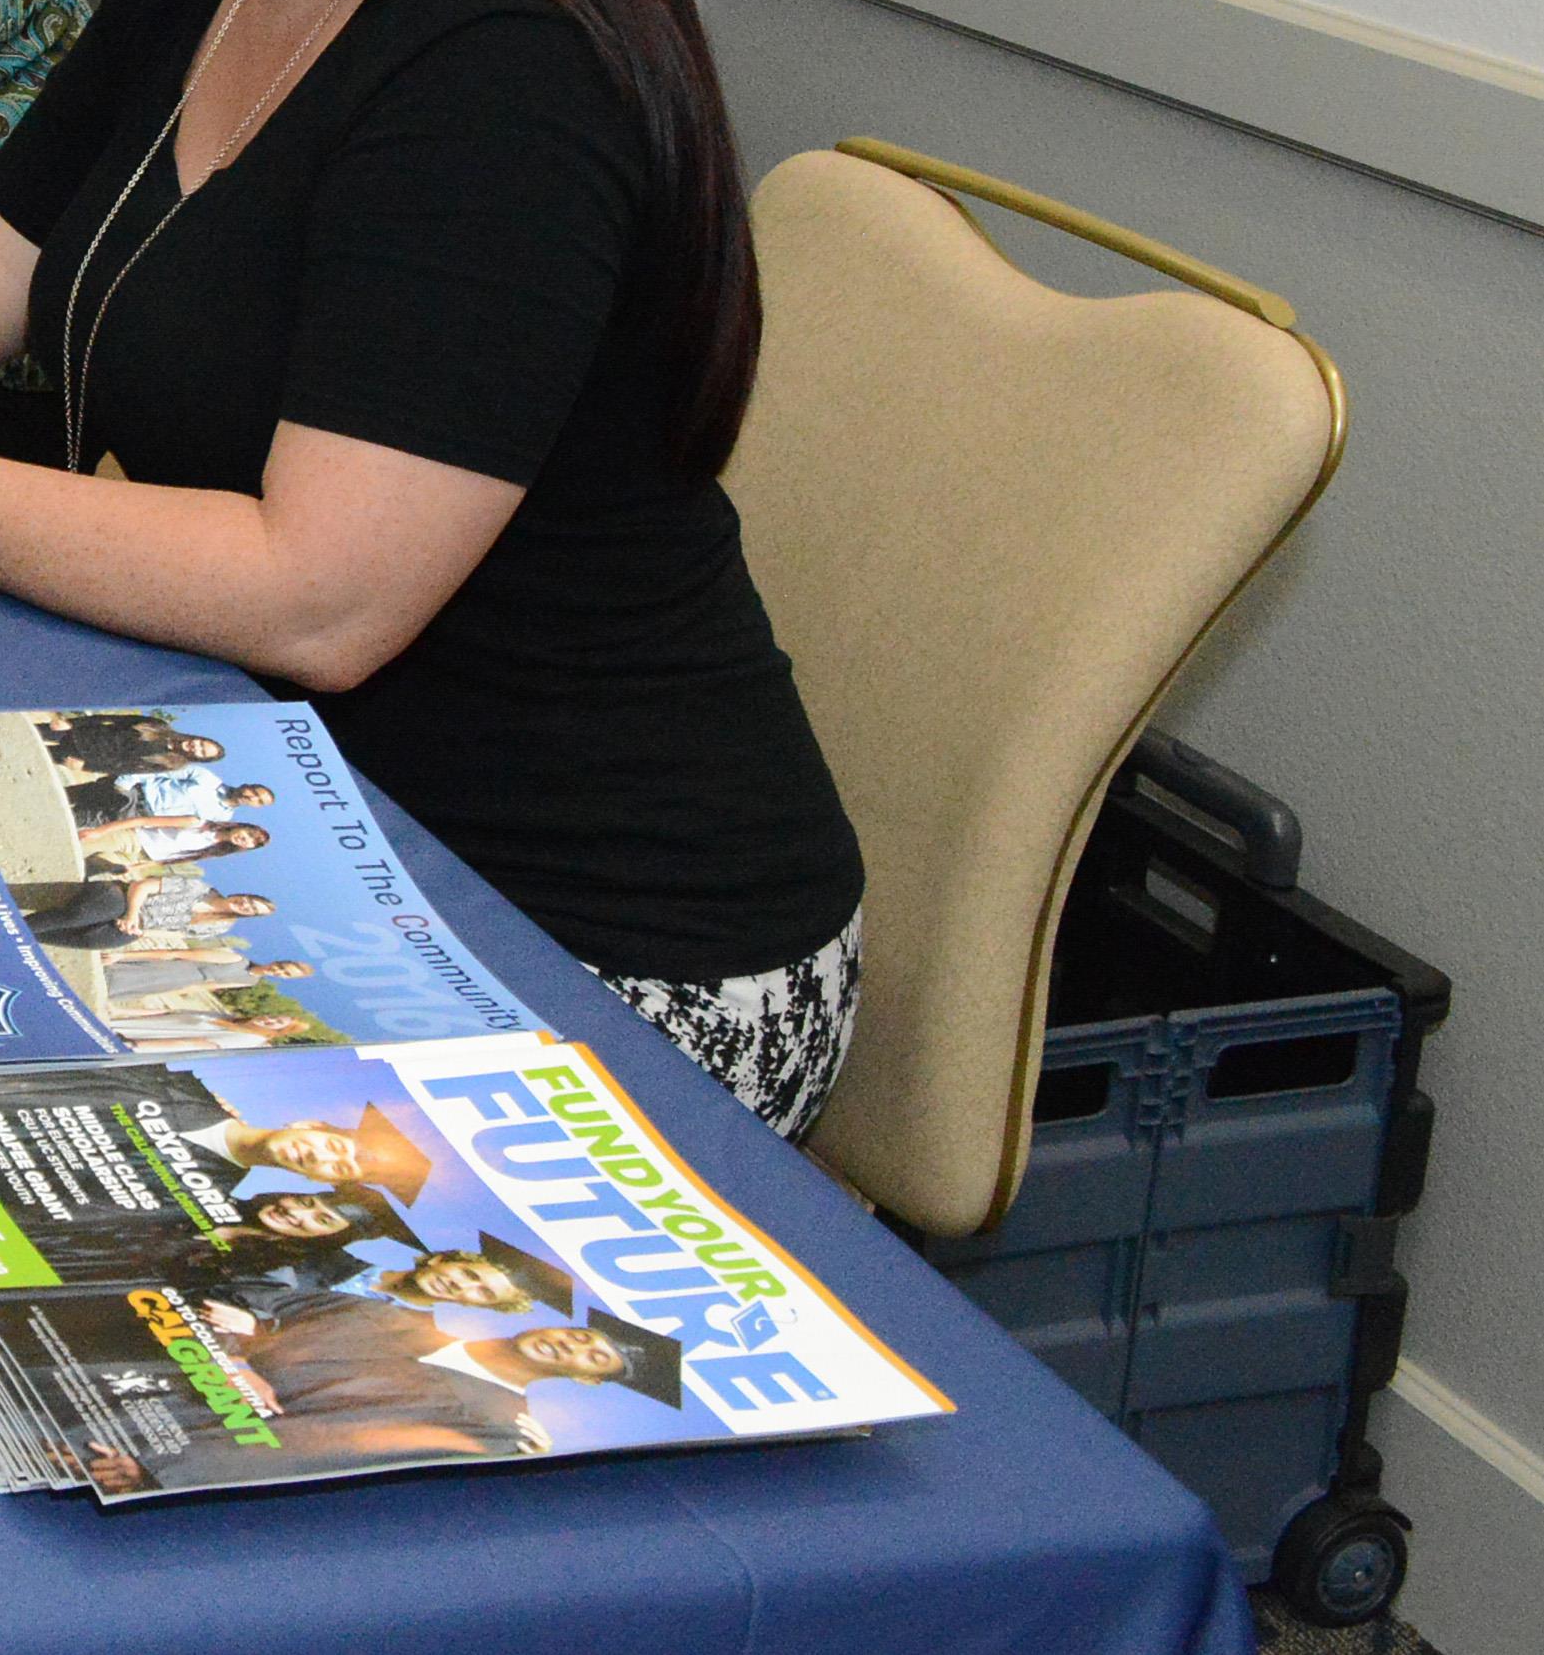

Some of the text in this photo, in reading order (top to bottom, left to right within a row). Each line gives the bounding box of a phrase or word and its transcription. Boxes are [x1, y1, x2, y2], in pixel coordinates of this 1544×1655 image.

[274, 719, 529, 1030] Report To The Community
[15, 945, 64, 997] Improving
[55, 999, 119, 1053] Communities
[288, 921, 486, 1037] 2016
[20, 1171, 73, 1222] GRANT
[48, 1106, 138, 1209] SCHOLARSHIP
[69, 1105, 161, 1210] MIDDLE CLASS
[136, 1116, 242, 1223] EXPLORE!
[516, 1065, 796, 1301] FUND YOUR
[409, 1071, 842, 1412] FUTURE
